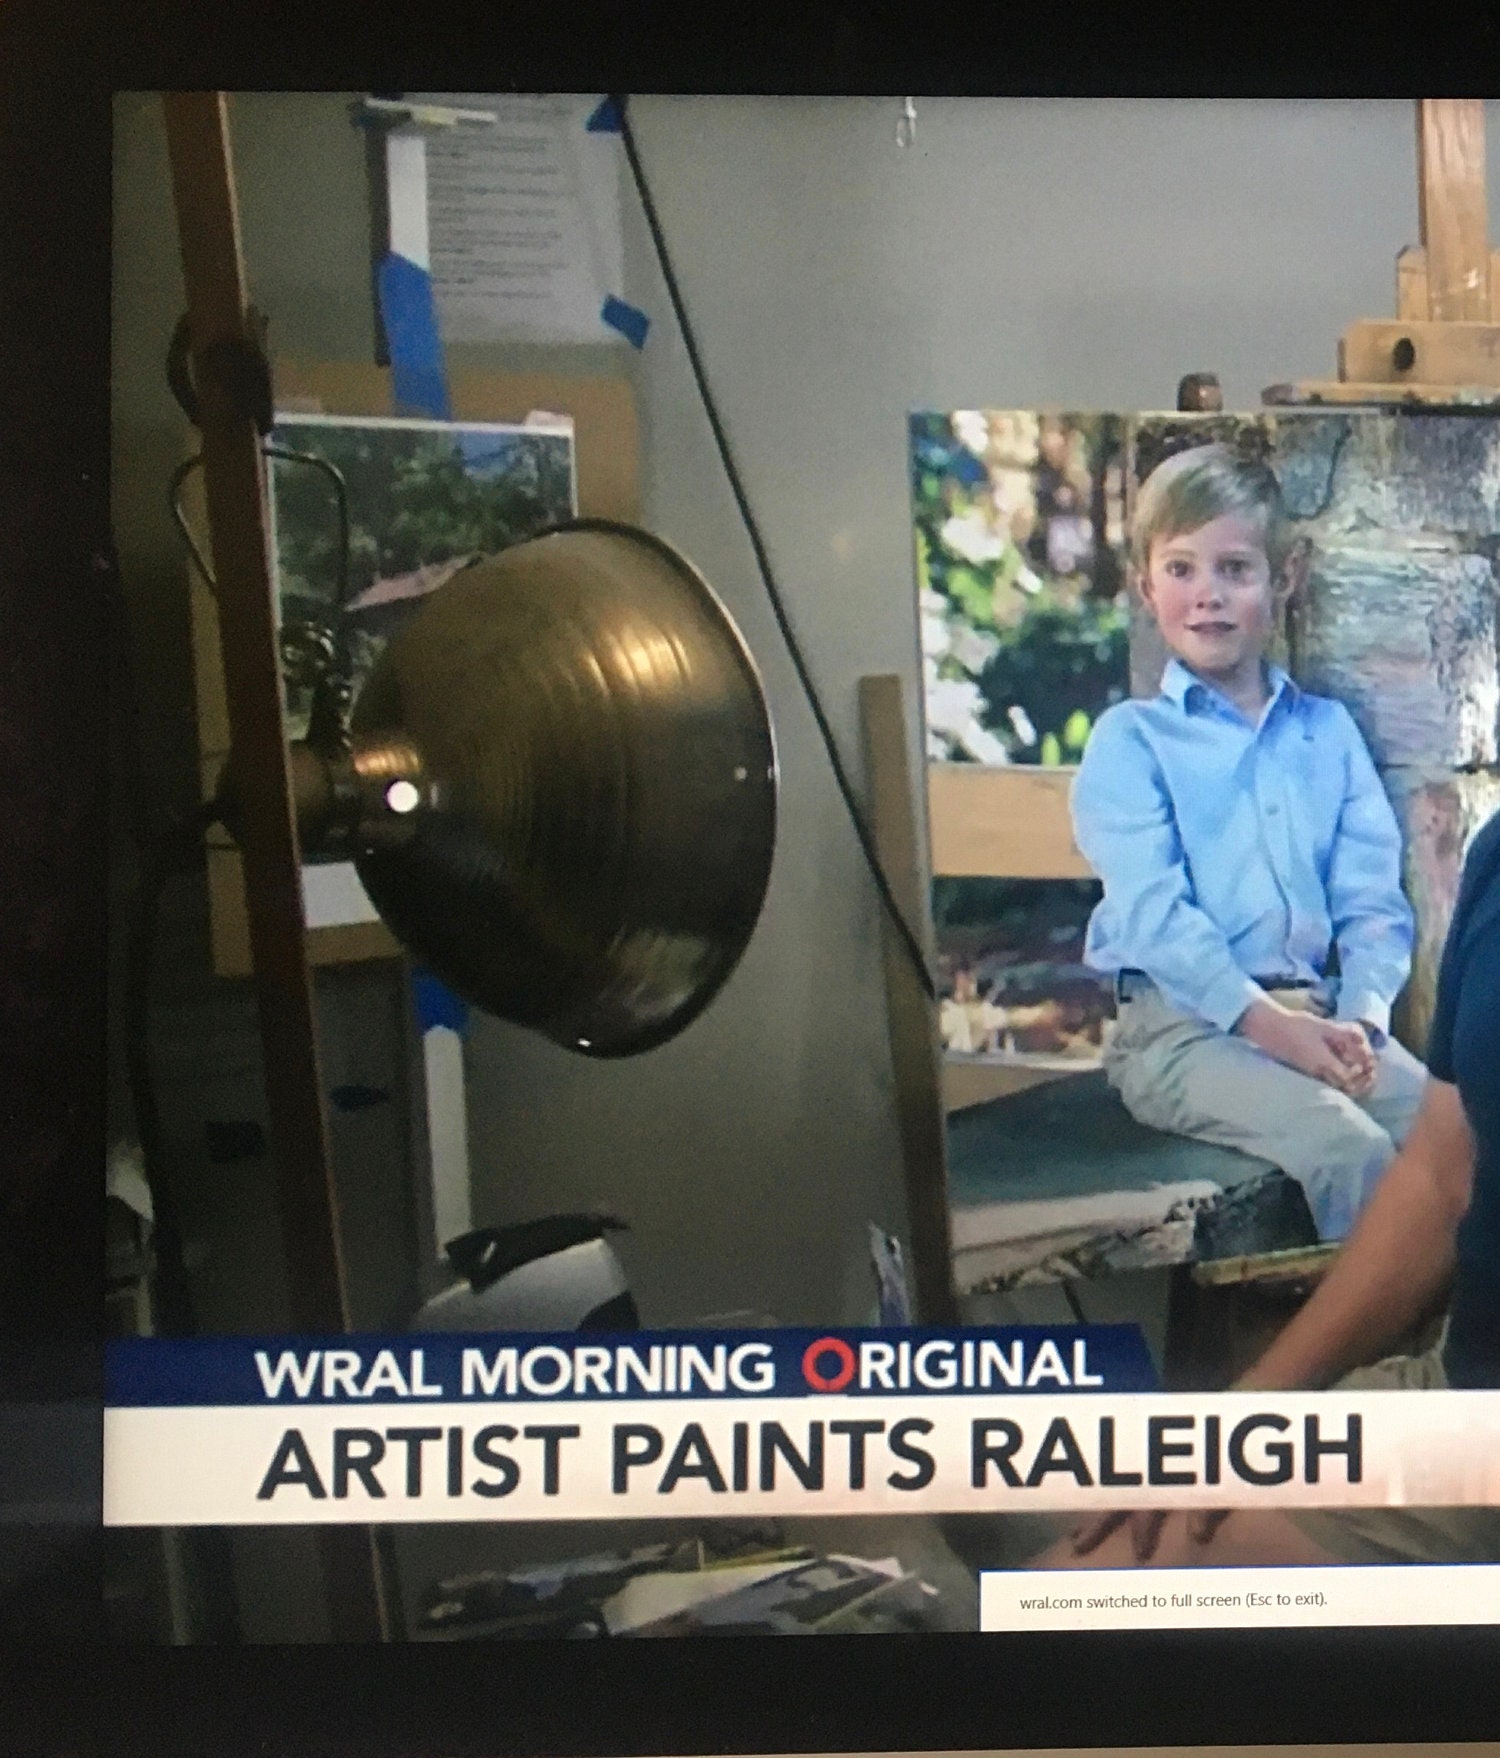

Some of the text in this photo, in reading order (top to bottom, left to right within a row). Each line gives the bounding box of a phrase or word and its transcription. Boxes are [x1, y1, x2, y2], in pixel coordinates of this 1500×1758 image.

[254, 1337, 1104, 1398] WRAL MORNING ORIGINAL
[256, 1413, 1363, 1500] ARTIST PAINTS RALEIGH
[1020, 1591, 1328, 1610] wral.com switched to full screen (Esc to exit).
